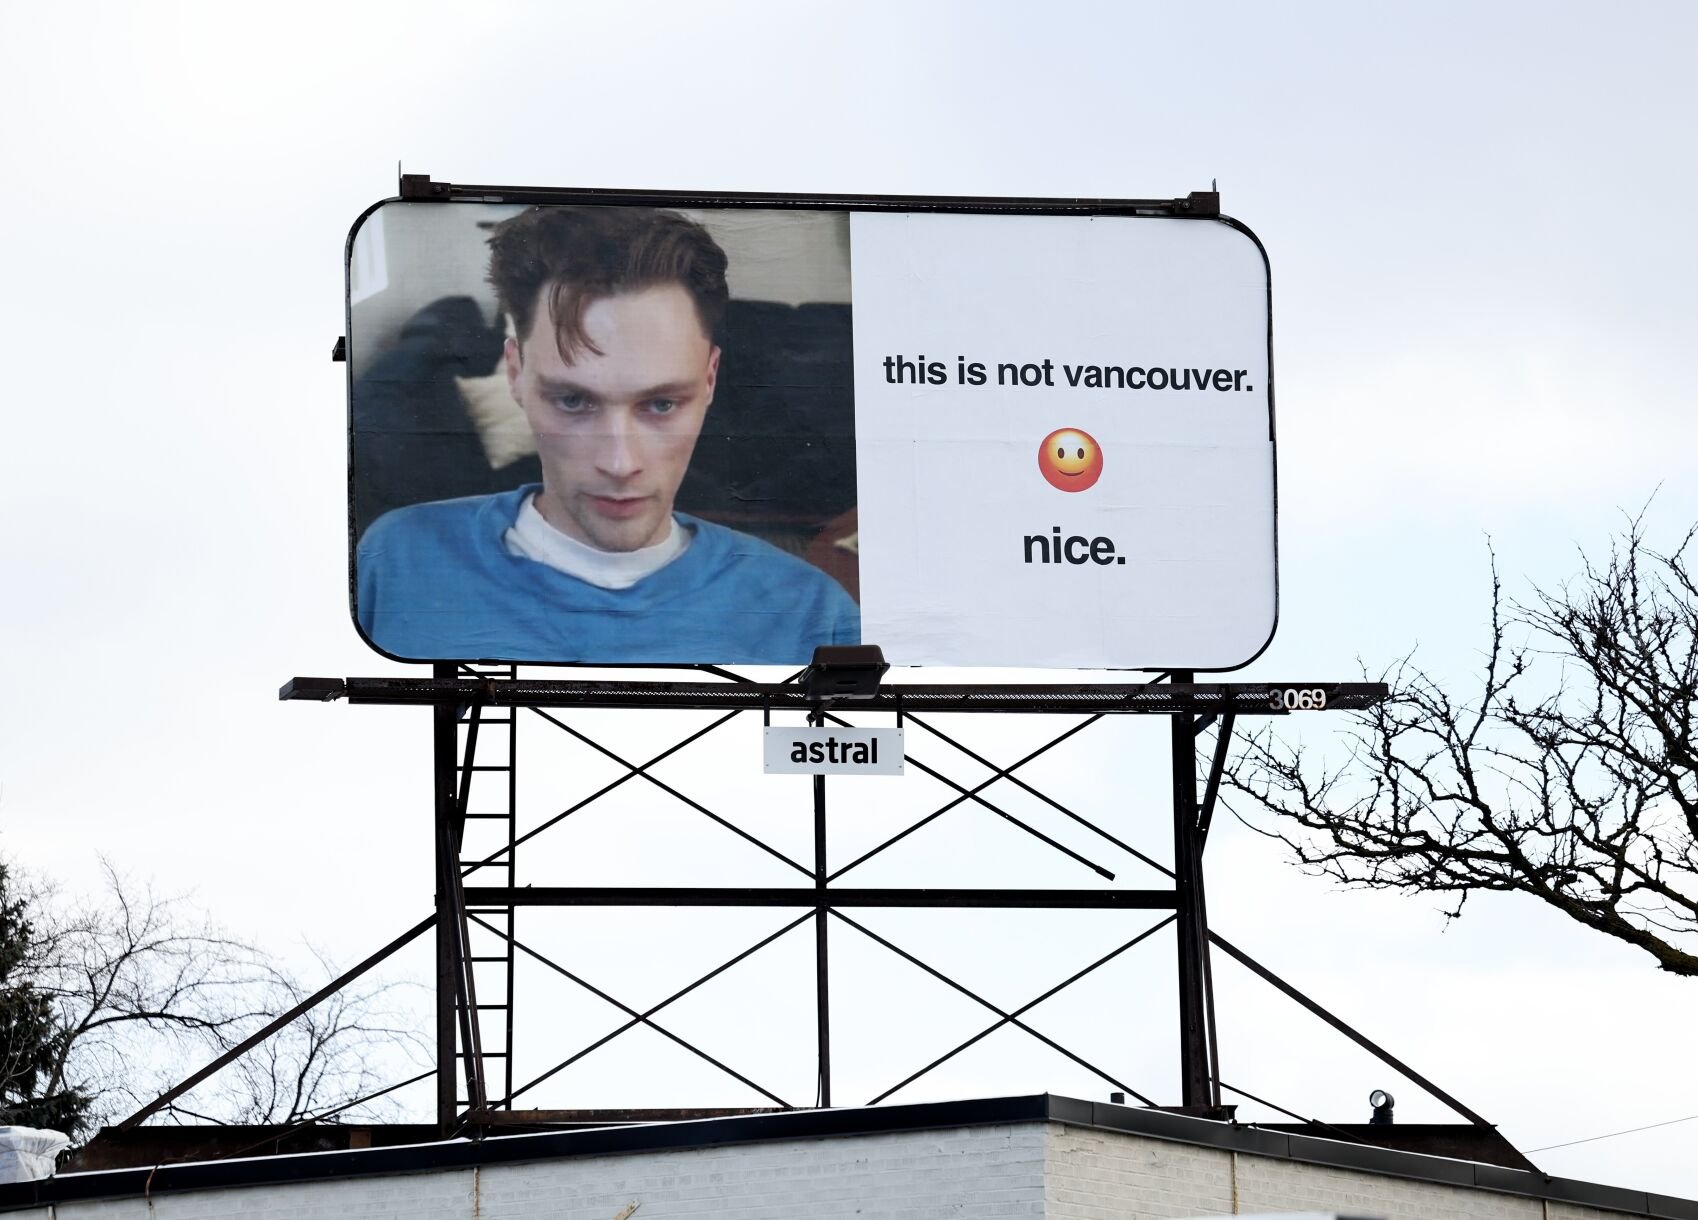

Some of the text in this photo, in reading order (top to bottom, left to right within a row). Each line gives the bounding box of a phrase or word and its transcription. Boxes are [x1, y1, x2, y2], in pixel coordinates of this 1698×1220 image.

[883, 355, 1254, 392] this is not vancouver.
[1023, 526, 1126, 566] nice.
[1269, 688, 1326, 710] 3069
[790, 736, 878, 764] astral
